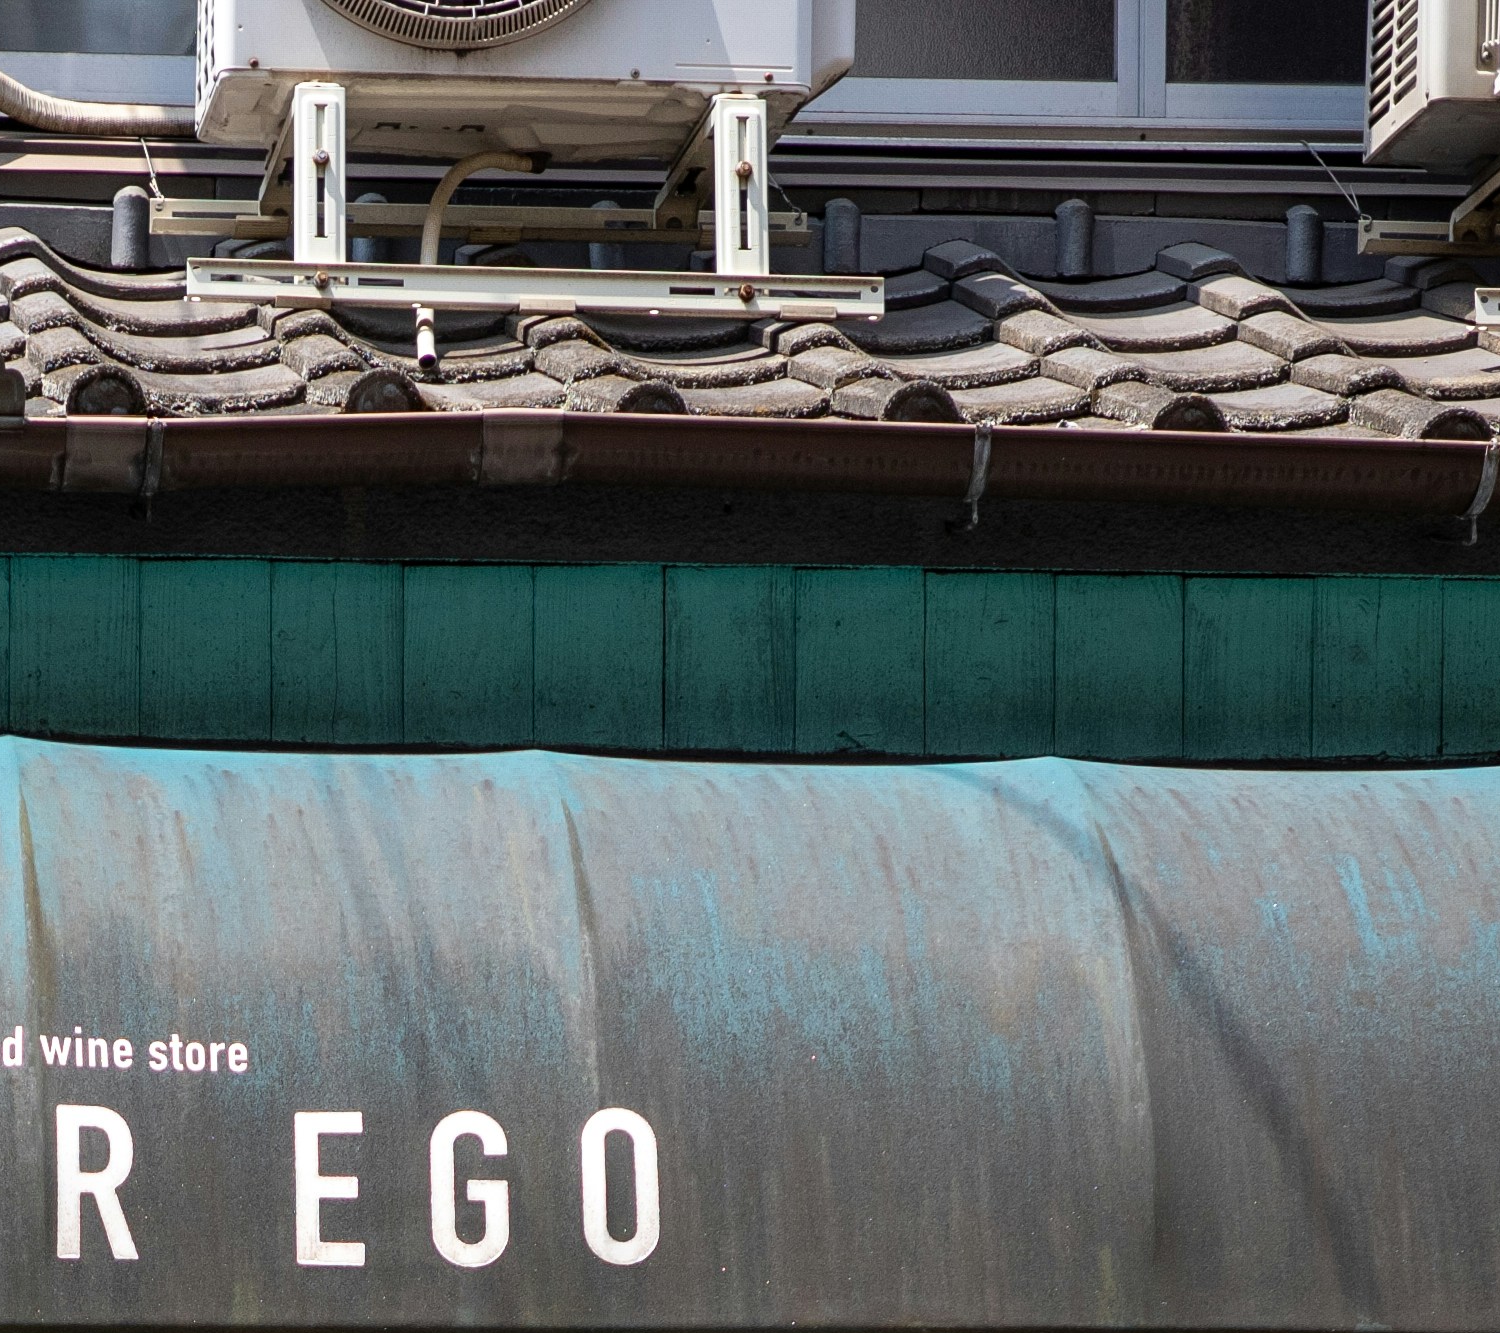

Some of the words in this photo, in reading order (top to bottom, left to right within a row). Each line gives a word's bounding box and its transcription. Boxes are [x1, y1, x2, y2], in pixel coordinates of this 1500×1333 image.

[39, 1024, 134, 1071] wine
[147, 1031, 250, 1074] store
[293, 1107, 660, 1268] EGO
